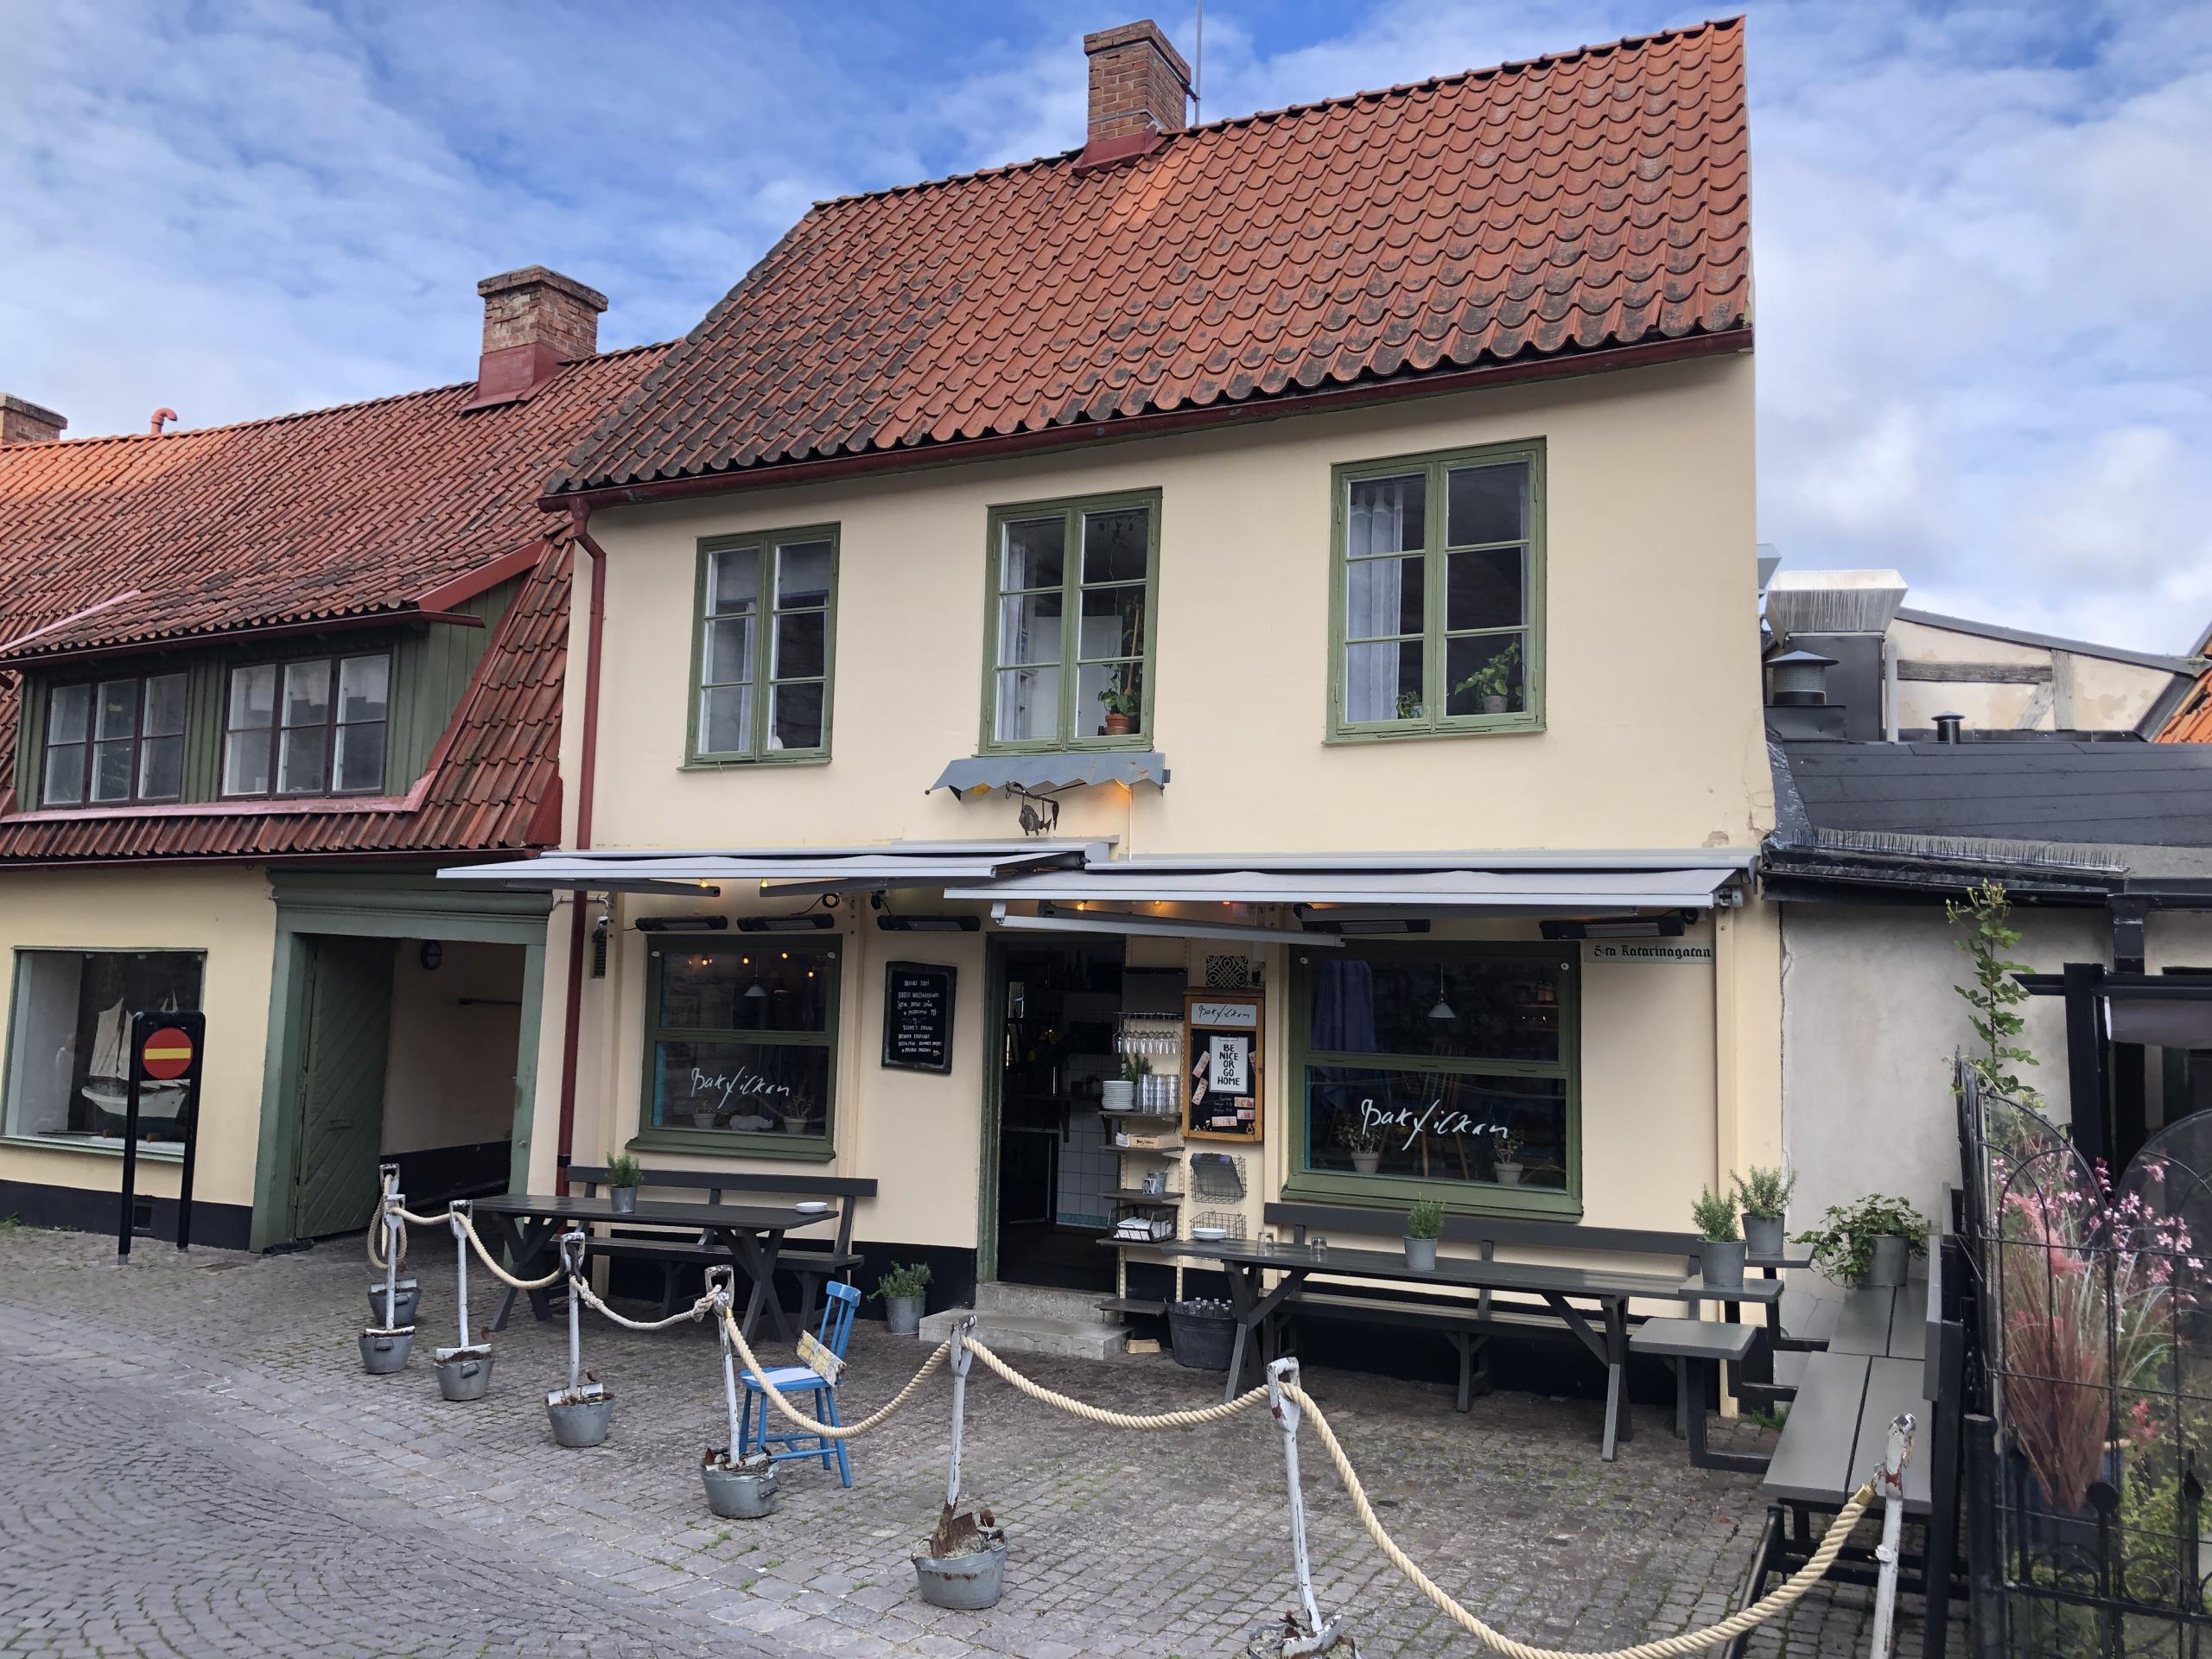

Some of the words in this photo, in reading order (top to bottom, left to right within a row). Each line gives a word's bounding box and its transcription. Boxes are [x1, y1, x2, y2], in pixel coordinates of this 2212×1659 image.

[1621, 944, 1711, 960] Katarinagatan
[1223, 1044, 1235, 1052] BE
[1219, 1052, 1239, 1061] NICE
[1223, 1059, 1235, 1069] OR
[1223, 1068, 1234, 1077] GO
[1217, 1077, 1241, 1086] HOME
